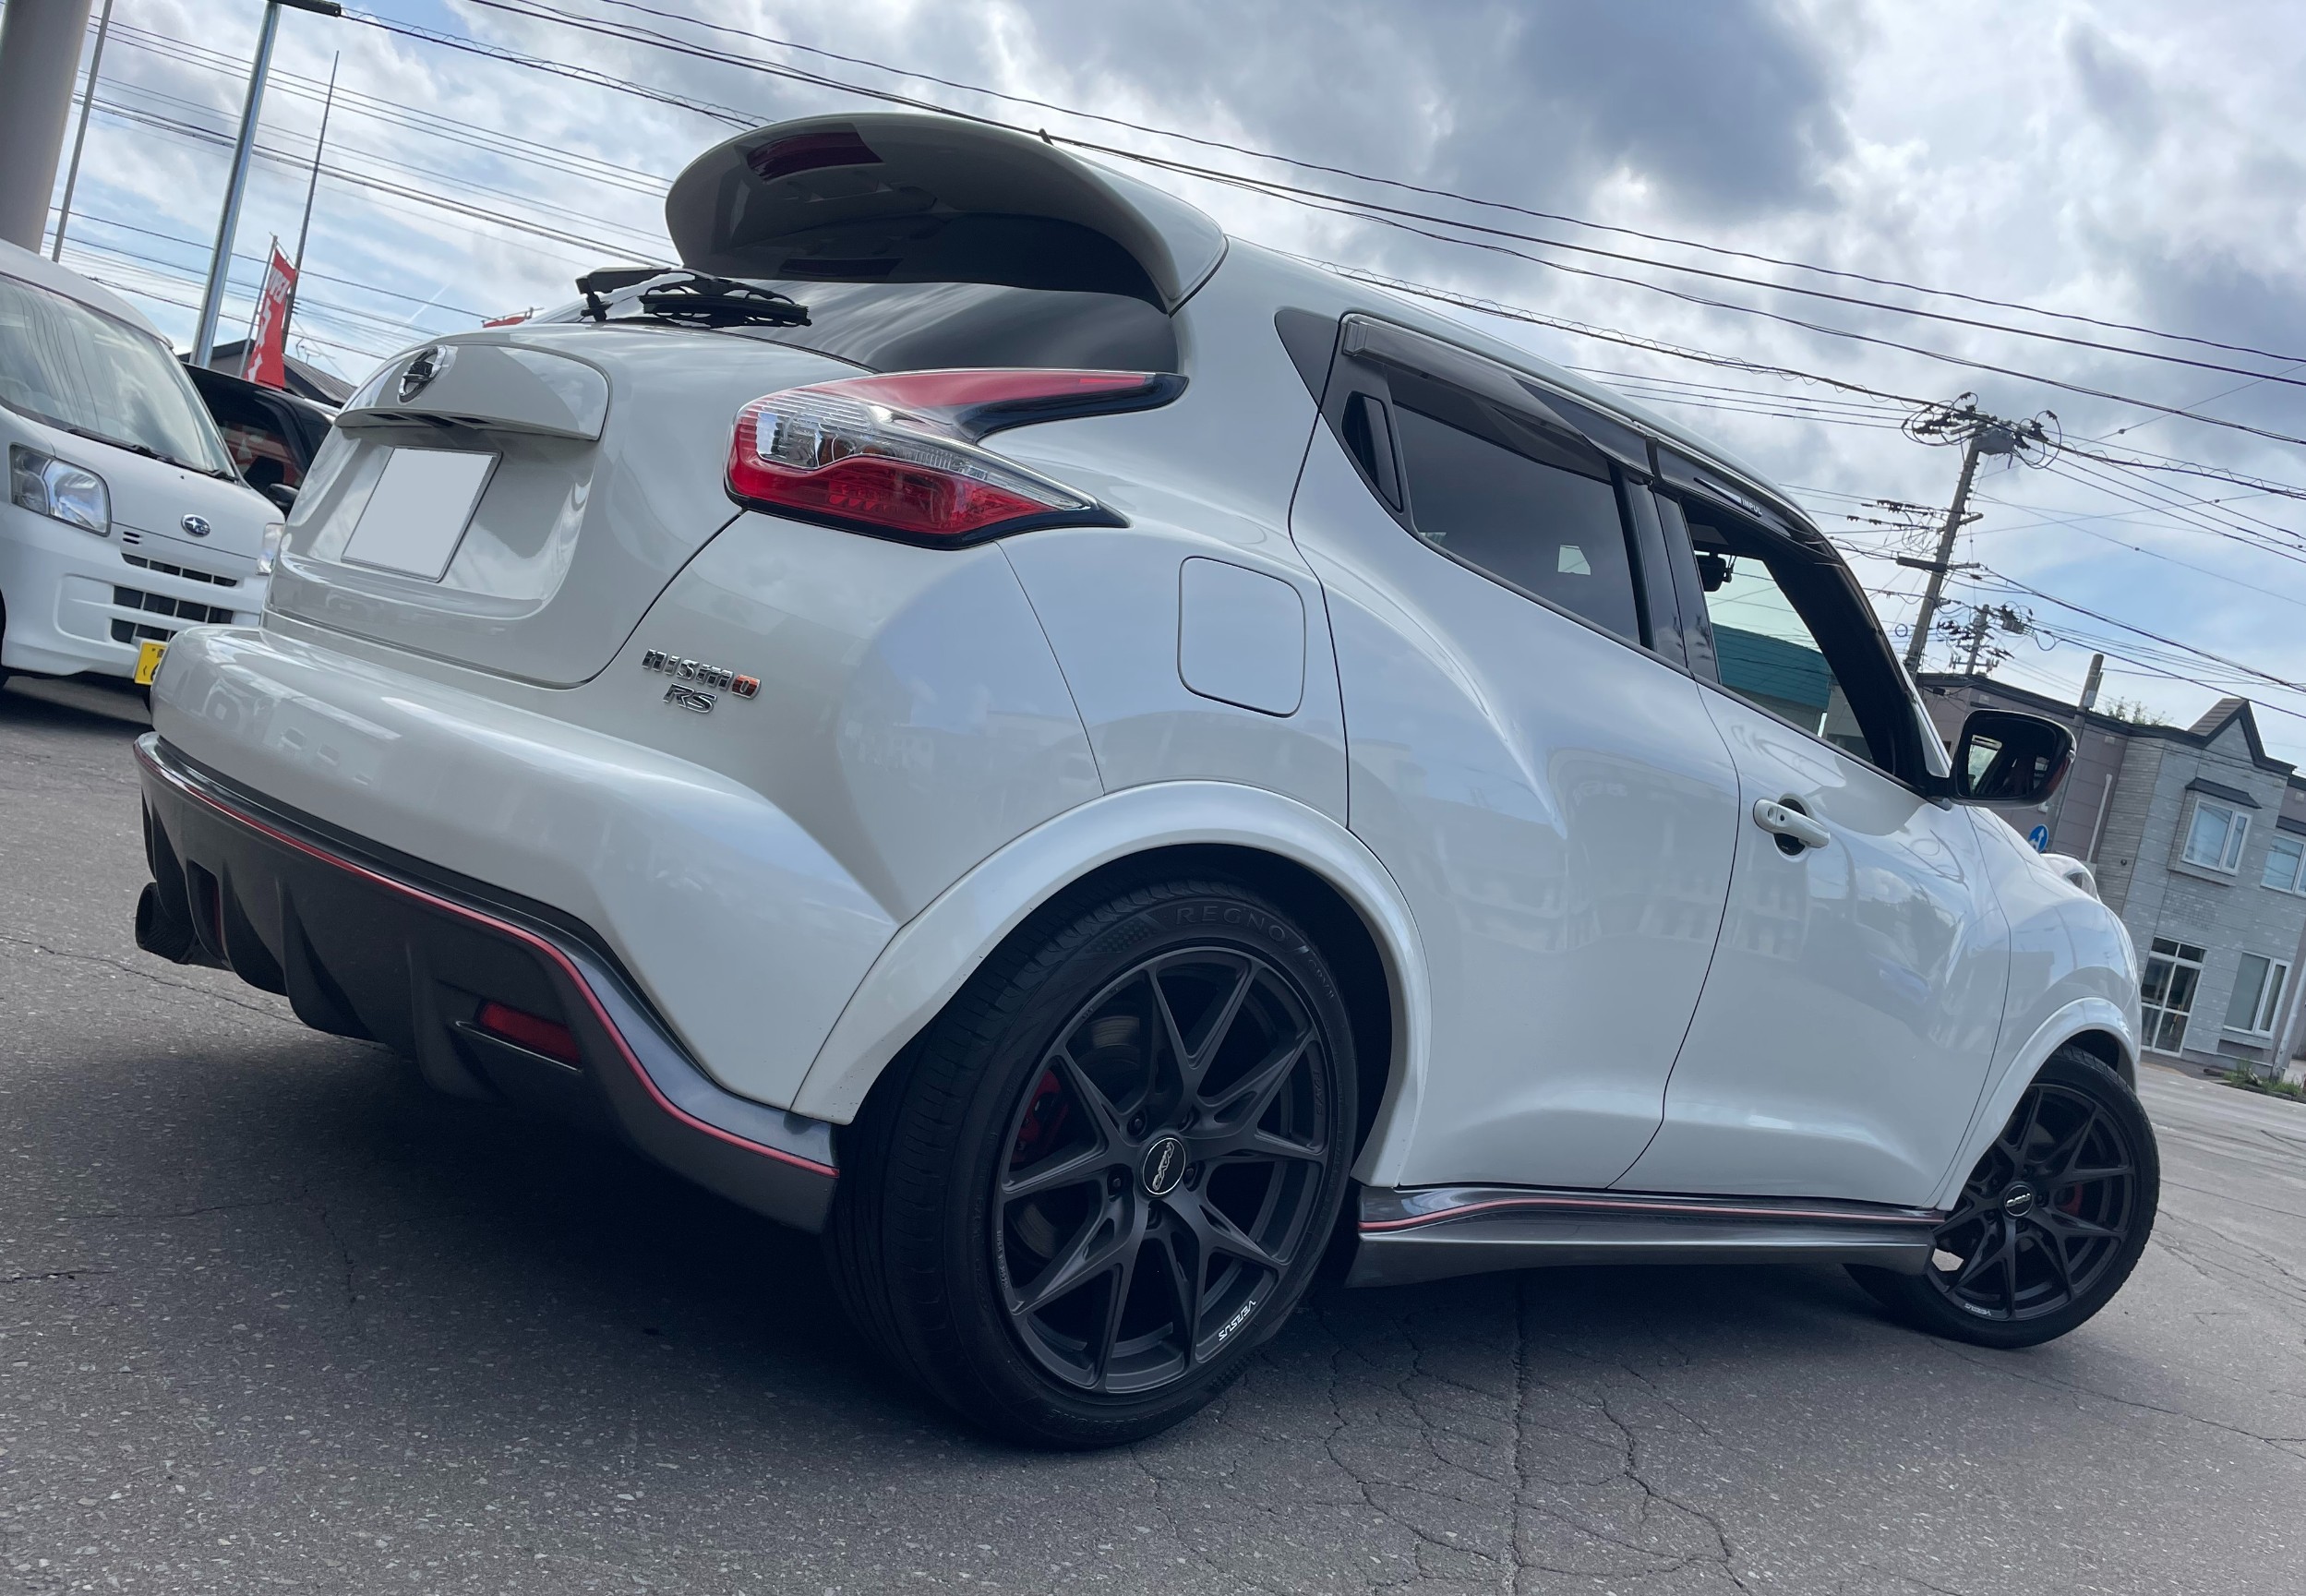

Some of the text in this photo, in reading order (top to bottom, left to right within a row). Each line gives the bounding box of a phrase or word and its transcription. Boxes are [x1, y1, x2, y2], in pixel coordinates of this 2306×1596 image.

[1742, 498, 1762, 515] IMPUL
[662, 682, 717, 714] RS
[1175, 906, 1286, 942] REGNO
[1219, 1300, 1256, 1341] VERSUS
